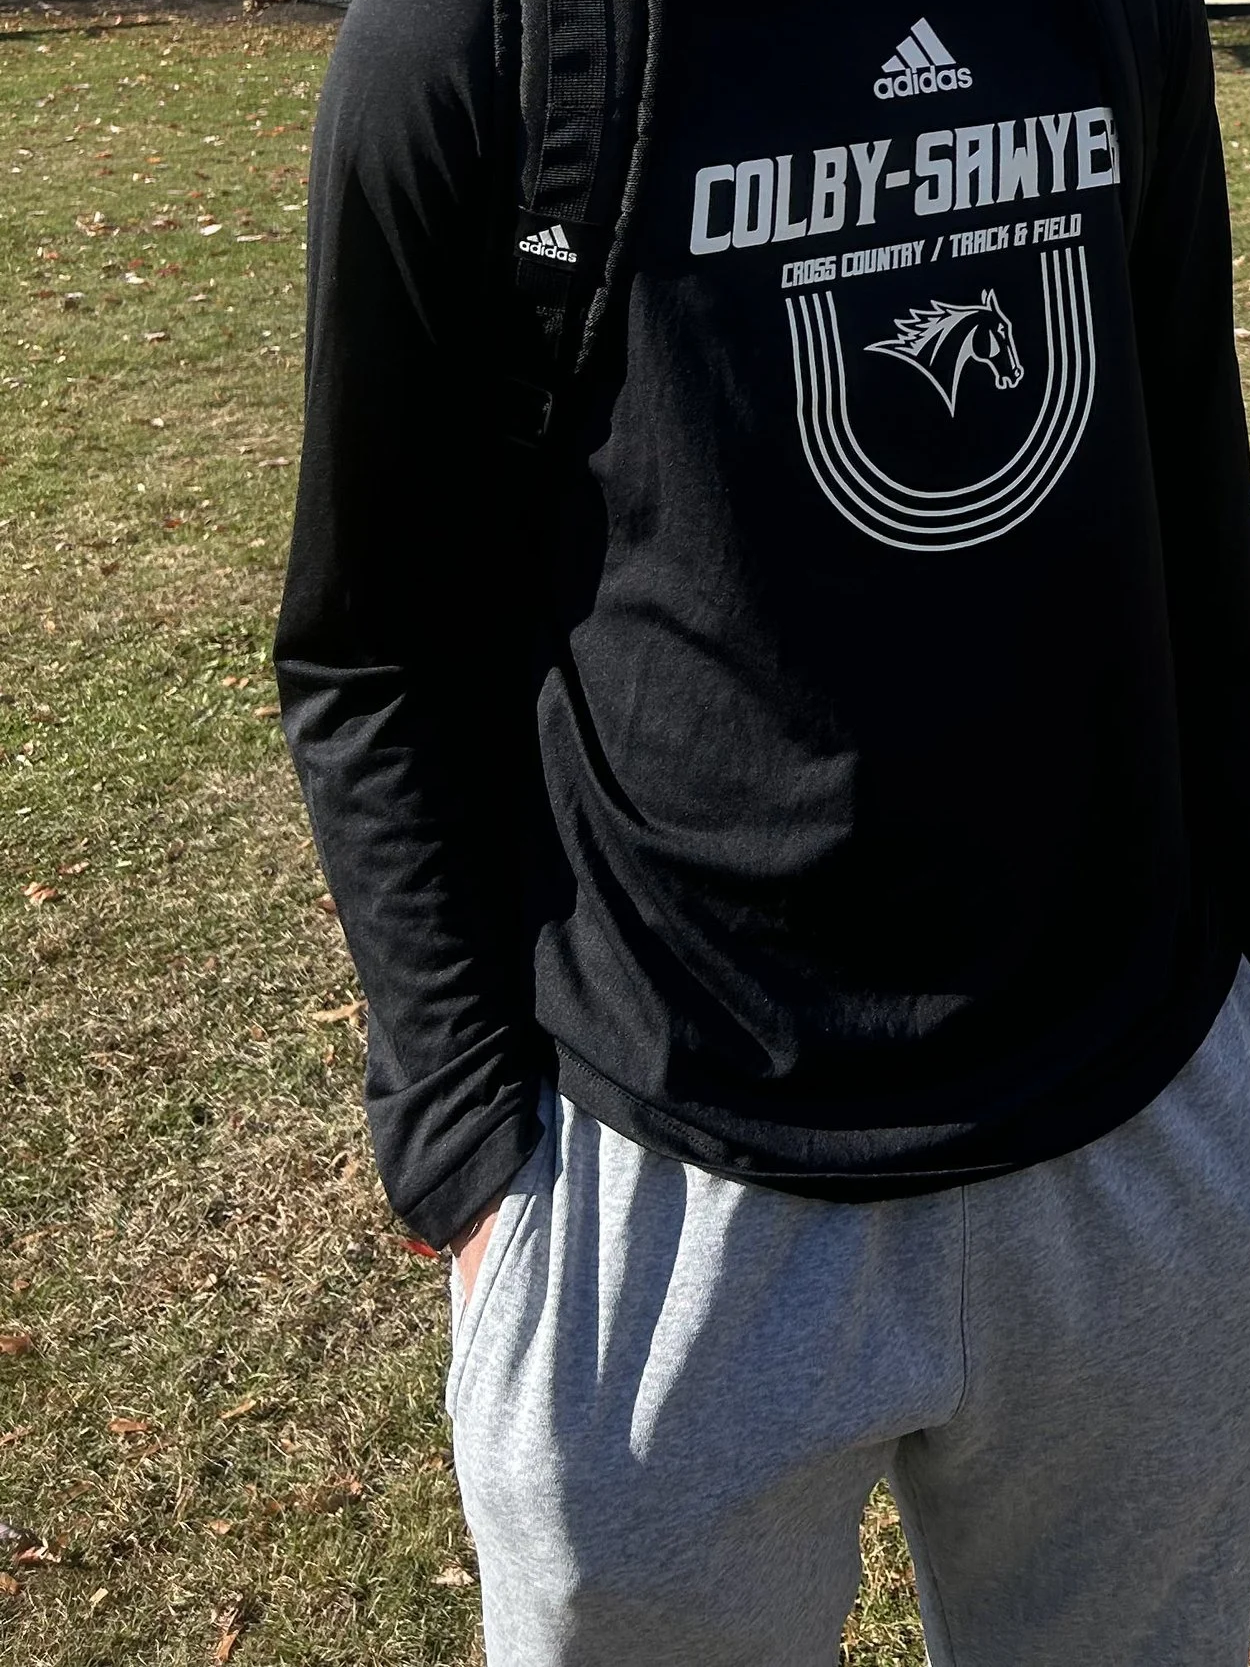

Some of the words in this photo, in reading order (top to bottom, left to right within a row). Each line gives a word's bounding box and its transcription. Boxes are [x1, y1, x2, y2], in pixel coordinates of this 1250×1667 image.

[873, 65, 973, 100] adidas
[519, 240, 578, 263] adidas
[781, 255, 837, 289] CROSS
[841, 239, 926, 278] COUNTRY
[949, 224, 1010, 258] TRACK
[1013, 221, 1028, 246] &
[1032, 213, 1082, 244] FIELD
